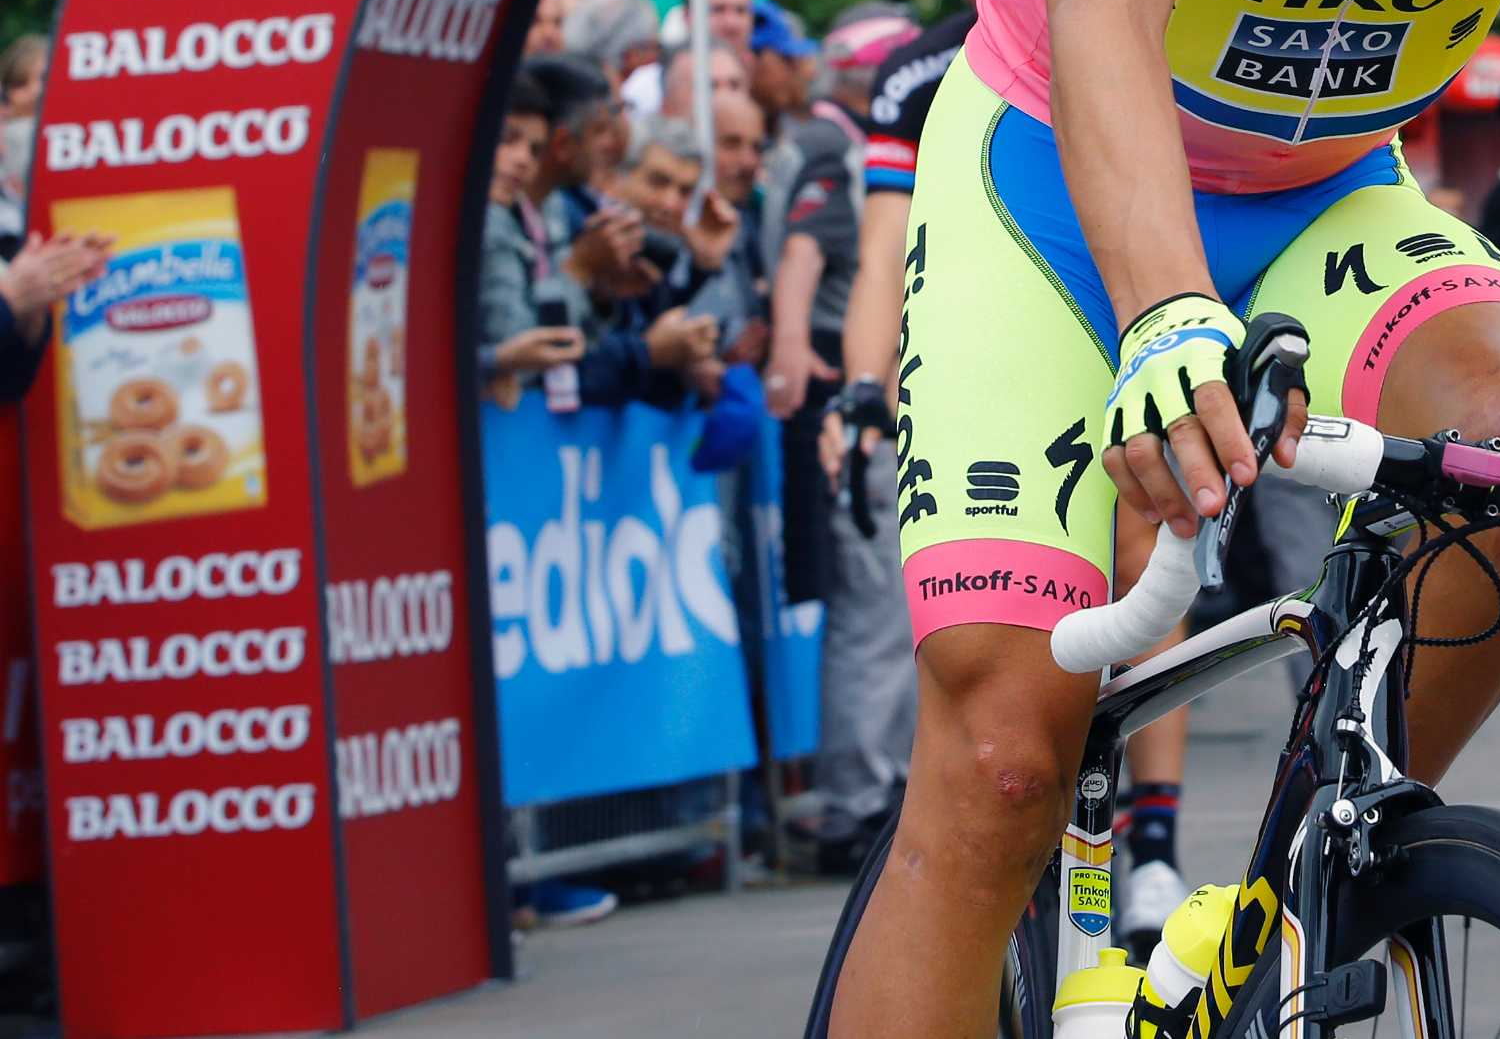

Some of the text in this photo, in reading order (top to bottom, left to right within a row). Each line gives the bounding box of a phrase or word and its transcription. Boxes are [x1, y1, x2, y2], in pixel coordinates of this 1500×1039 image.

[66, 14, 334, 81] BALOCCO
[1247, 24, 1394, 53] SAXO
[1233, 59, 1382, 90] BANK
[44, 105, 310, 172] BALOCCO
[964, 504, 1019, 517] sportful
[51, 548, 301, 607] BALOCCO
[918, 569, 1092, 610] Tinkoff-SAXO
[325, 569, 454, 665] ALOCCO
[57, 626, 306, 685] BALOCCO
[61, 704, 310, 763] BALOCCO
[334, 716, 462, 819] ALOCCO
[66, 783, 315, 842] BALOCCO
[1073, 884, 1110, 898] Tinkoff
[1078, 896, 1107, 909] SAXO
